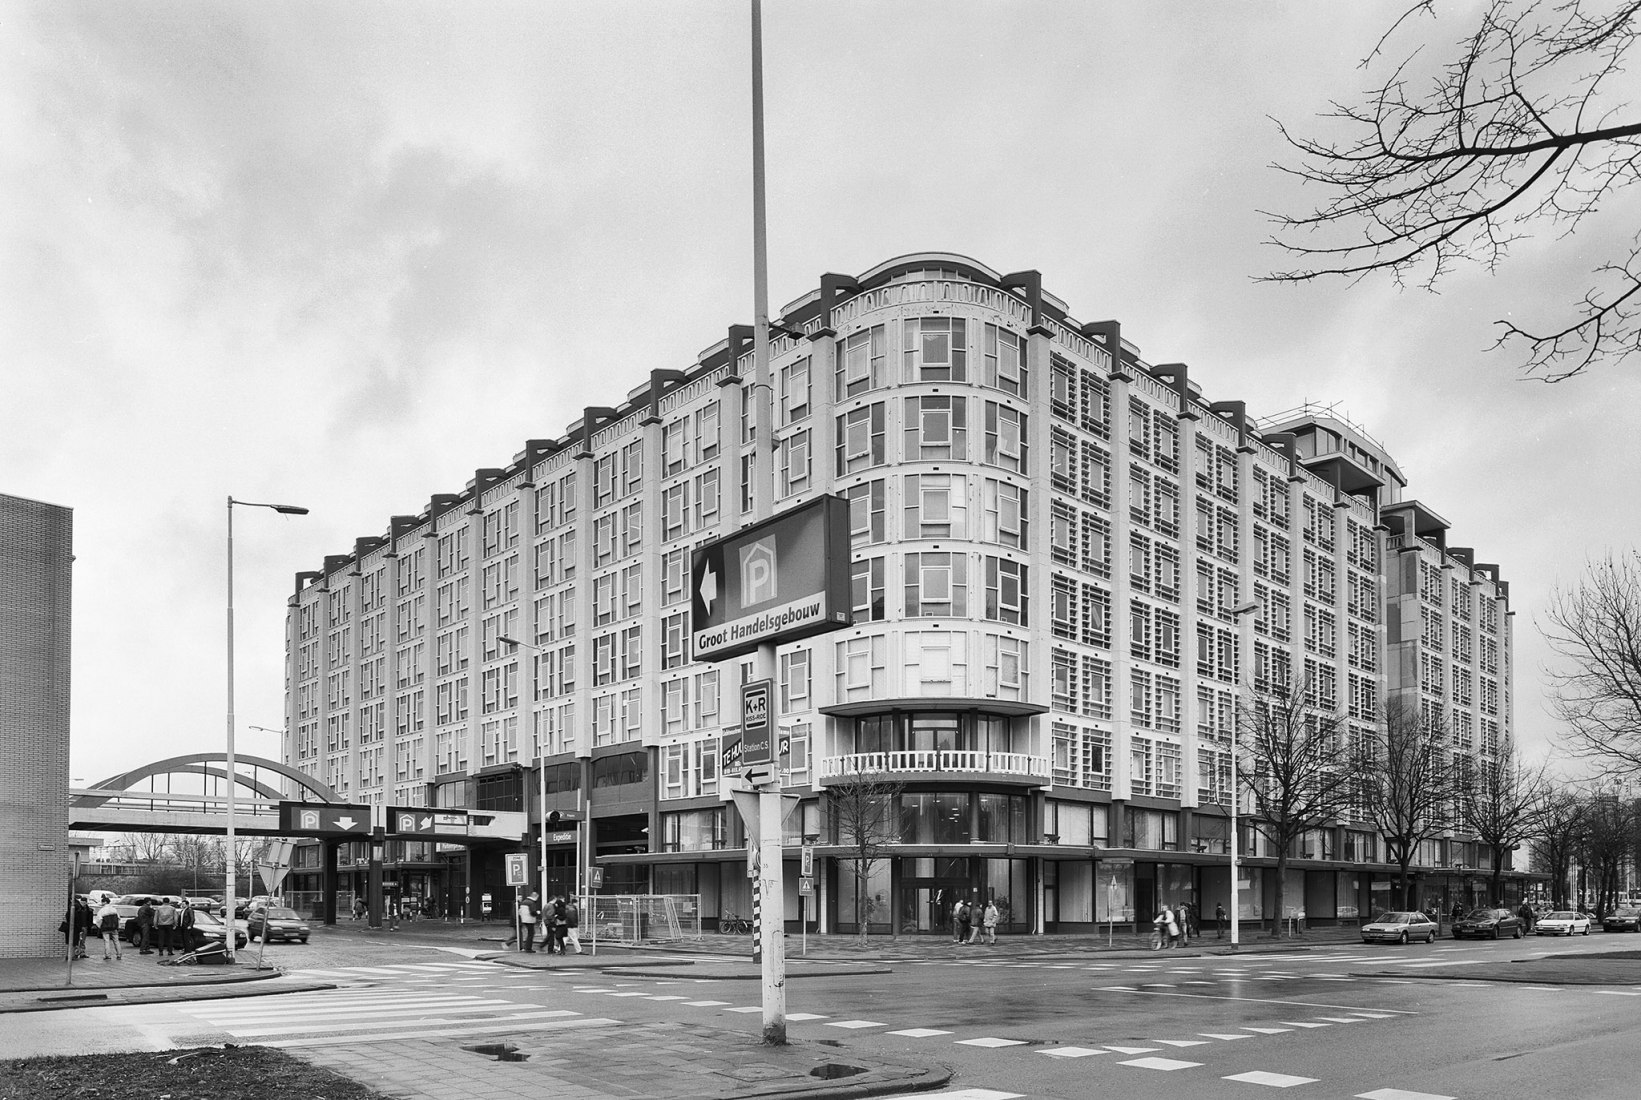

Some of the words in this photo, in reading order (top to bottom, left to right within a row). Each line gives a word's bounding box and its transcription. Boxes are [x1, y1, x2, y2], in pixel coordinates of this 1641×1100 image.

[750, 558, 769, 604] P
[699, 629, 728, 650] Groot
[731, 602, 820, 642] Handelsgebouw
[746, 697, 766, 715] K+R
[744, 743, 760, 753] Station
[723, 750, 731, 766] TE
[305, 816, 315, 830] P
[402, 818, 412, 831] P
[553, 832, 572, 843] Expeditie
[513, 864, 521, 876] P
